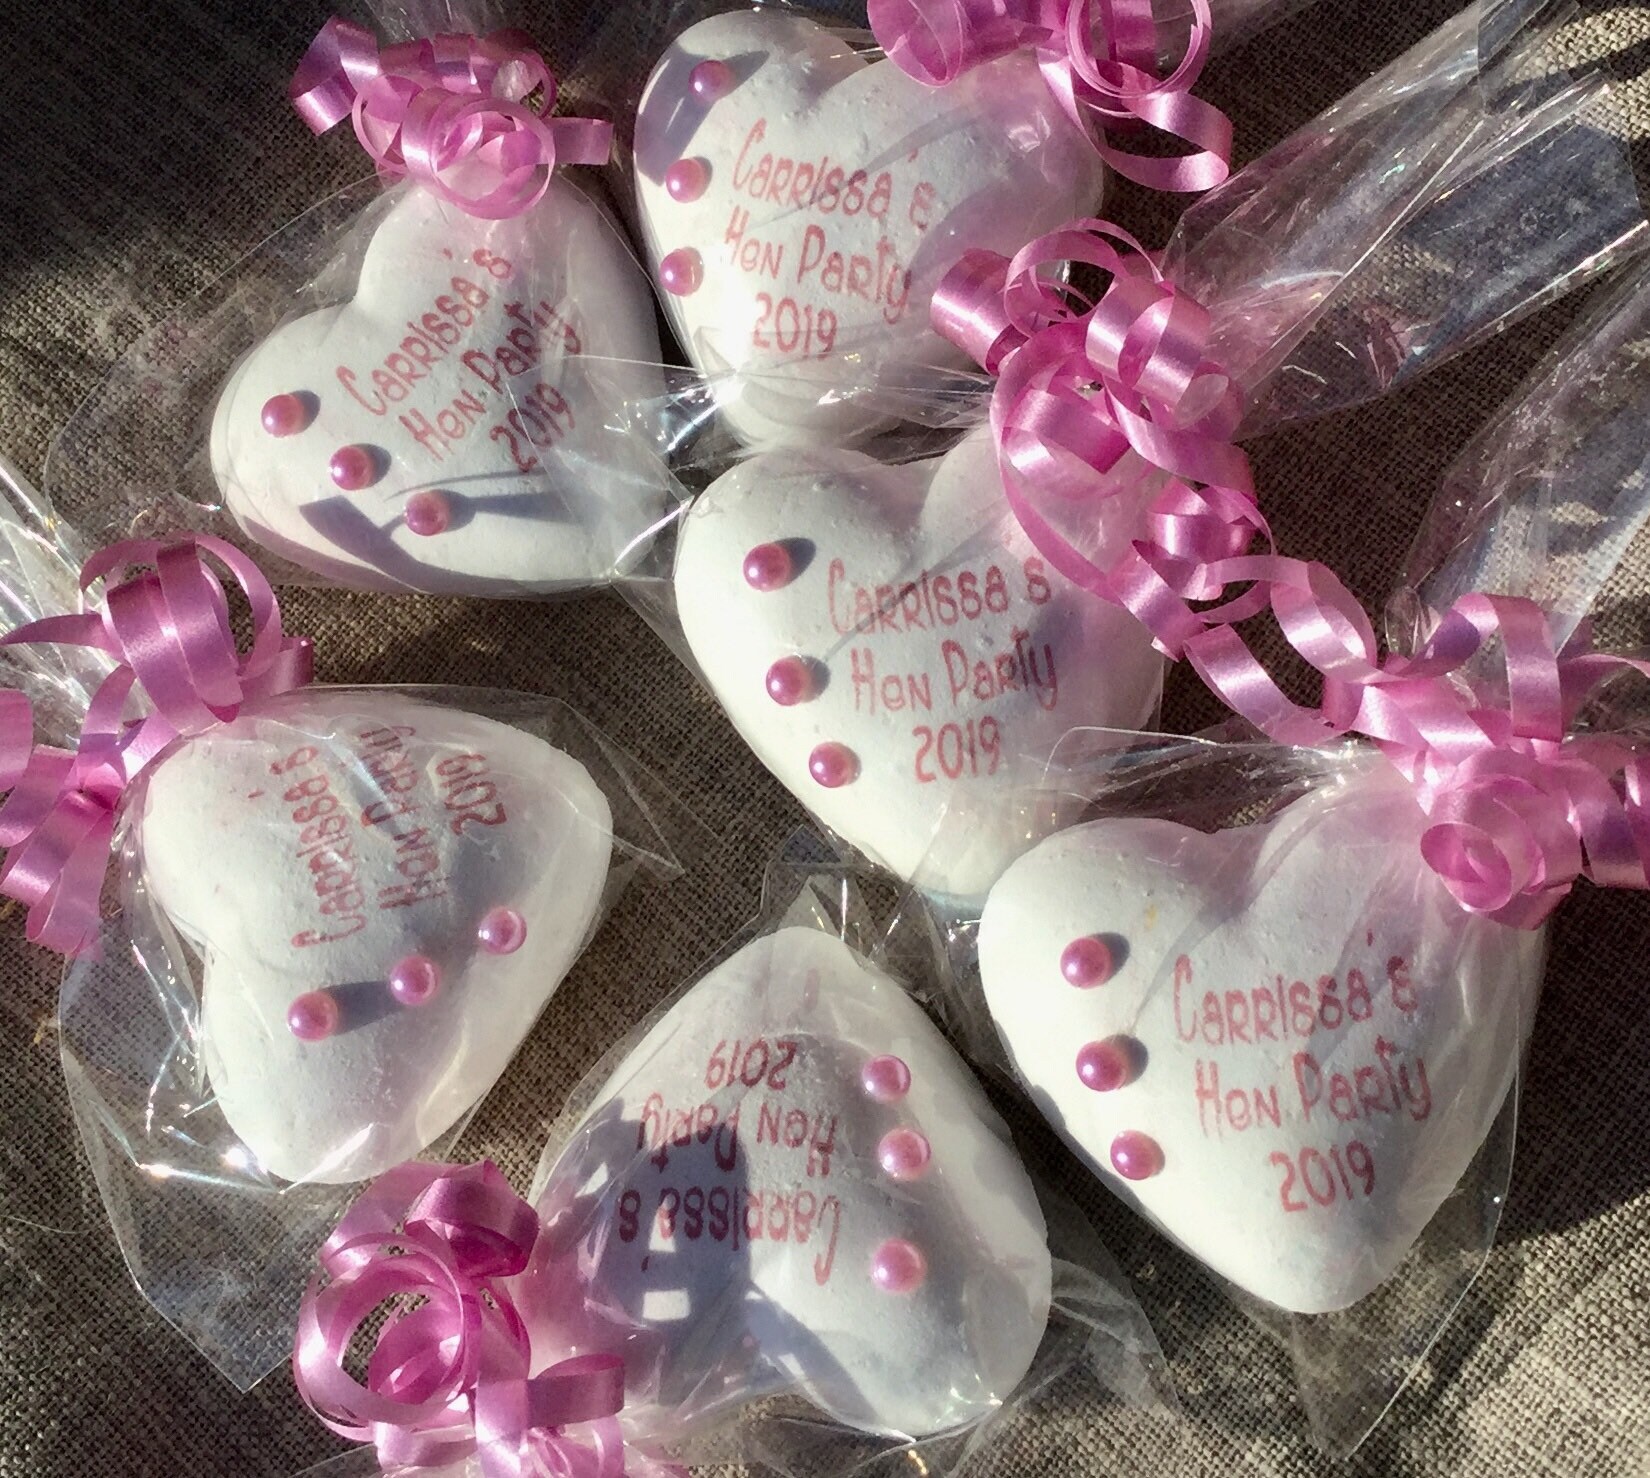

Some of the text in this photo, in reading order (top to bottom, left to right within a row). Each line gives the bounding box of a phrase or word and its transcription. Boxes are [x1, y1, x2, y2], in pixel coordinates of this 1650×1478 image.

[733, 117, 937, 231] Carrissa's
[725, 205, 913, 325] Hen Party
[336, 248, 513, 417] Carrissa's
[753, 291, 838, 360] 2019
[399, 388, 487, 462] Hen
[490, 383, 576, 473] 2019
[851, 625, 1058, 715] Hen Party
[912, 716, 1001, 783] 2019
[435, 754, 508, 836] 2019
[1174, 929, 1418, 1046] Carrissa's
[704, 1038, 799, 1090] 2019
[1195, 1034, 1432, 1142] Hen Party
[637, 1092, 838, 1178] Hen Party
[1269, 1140, 1375, 1212] 2019
